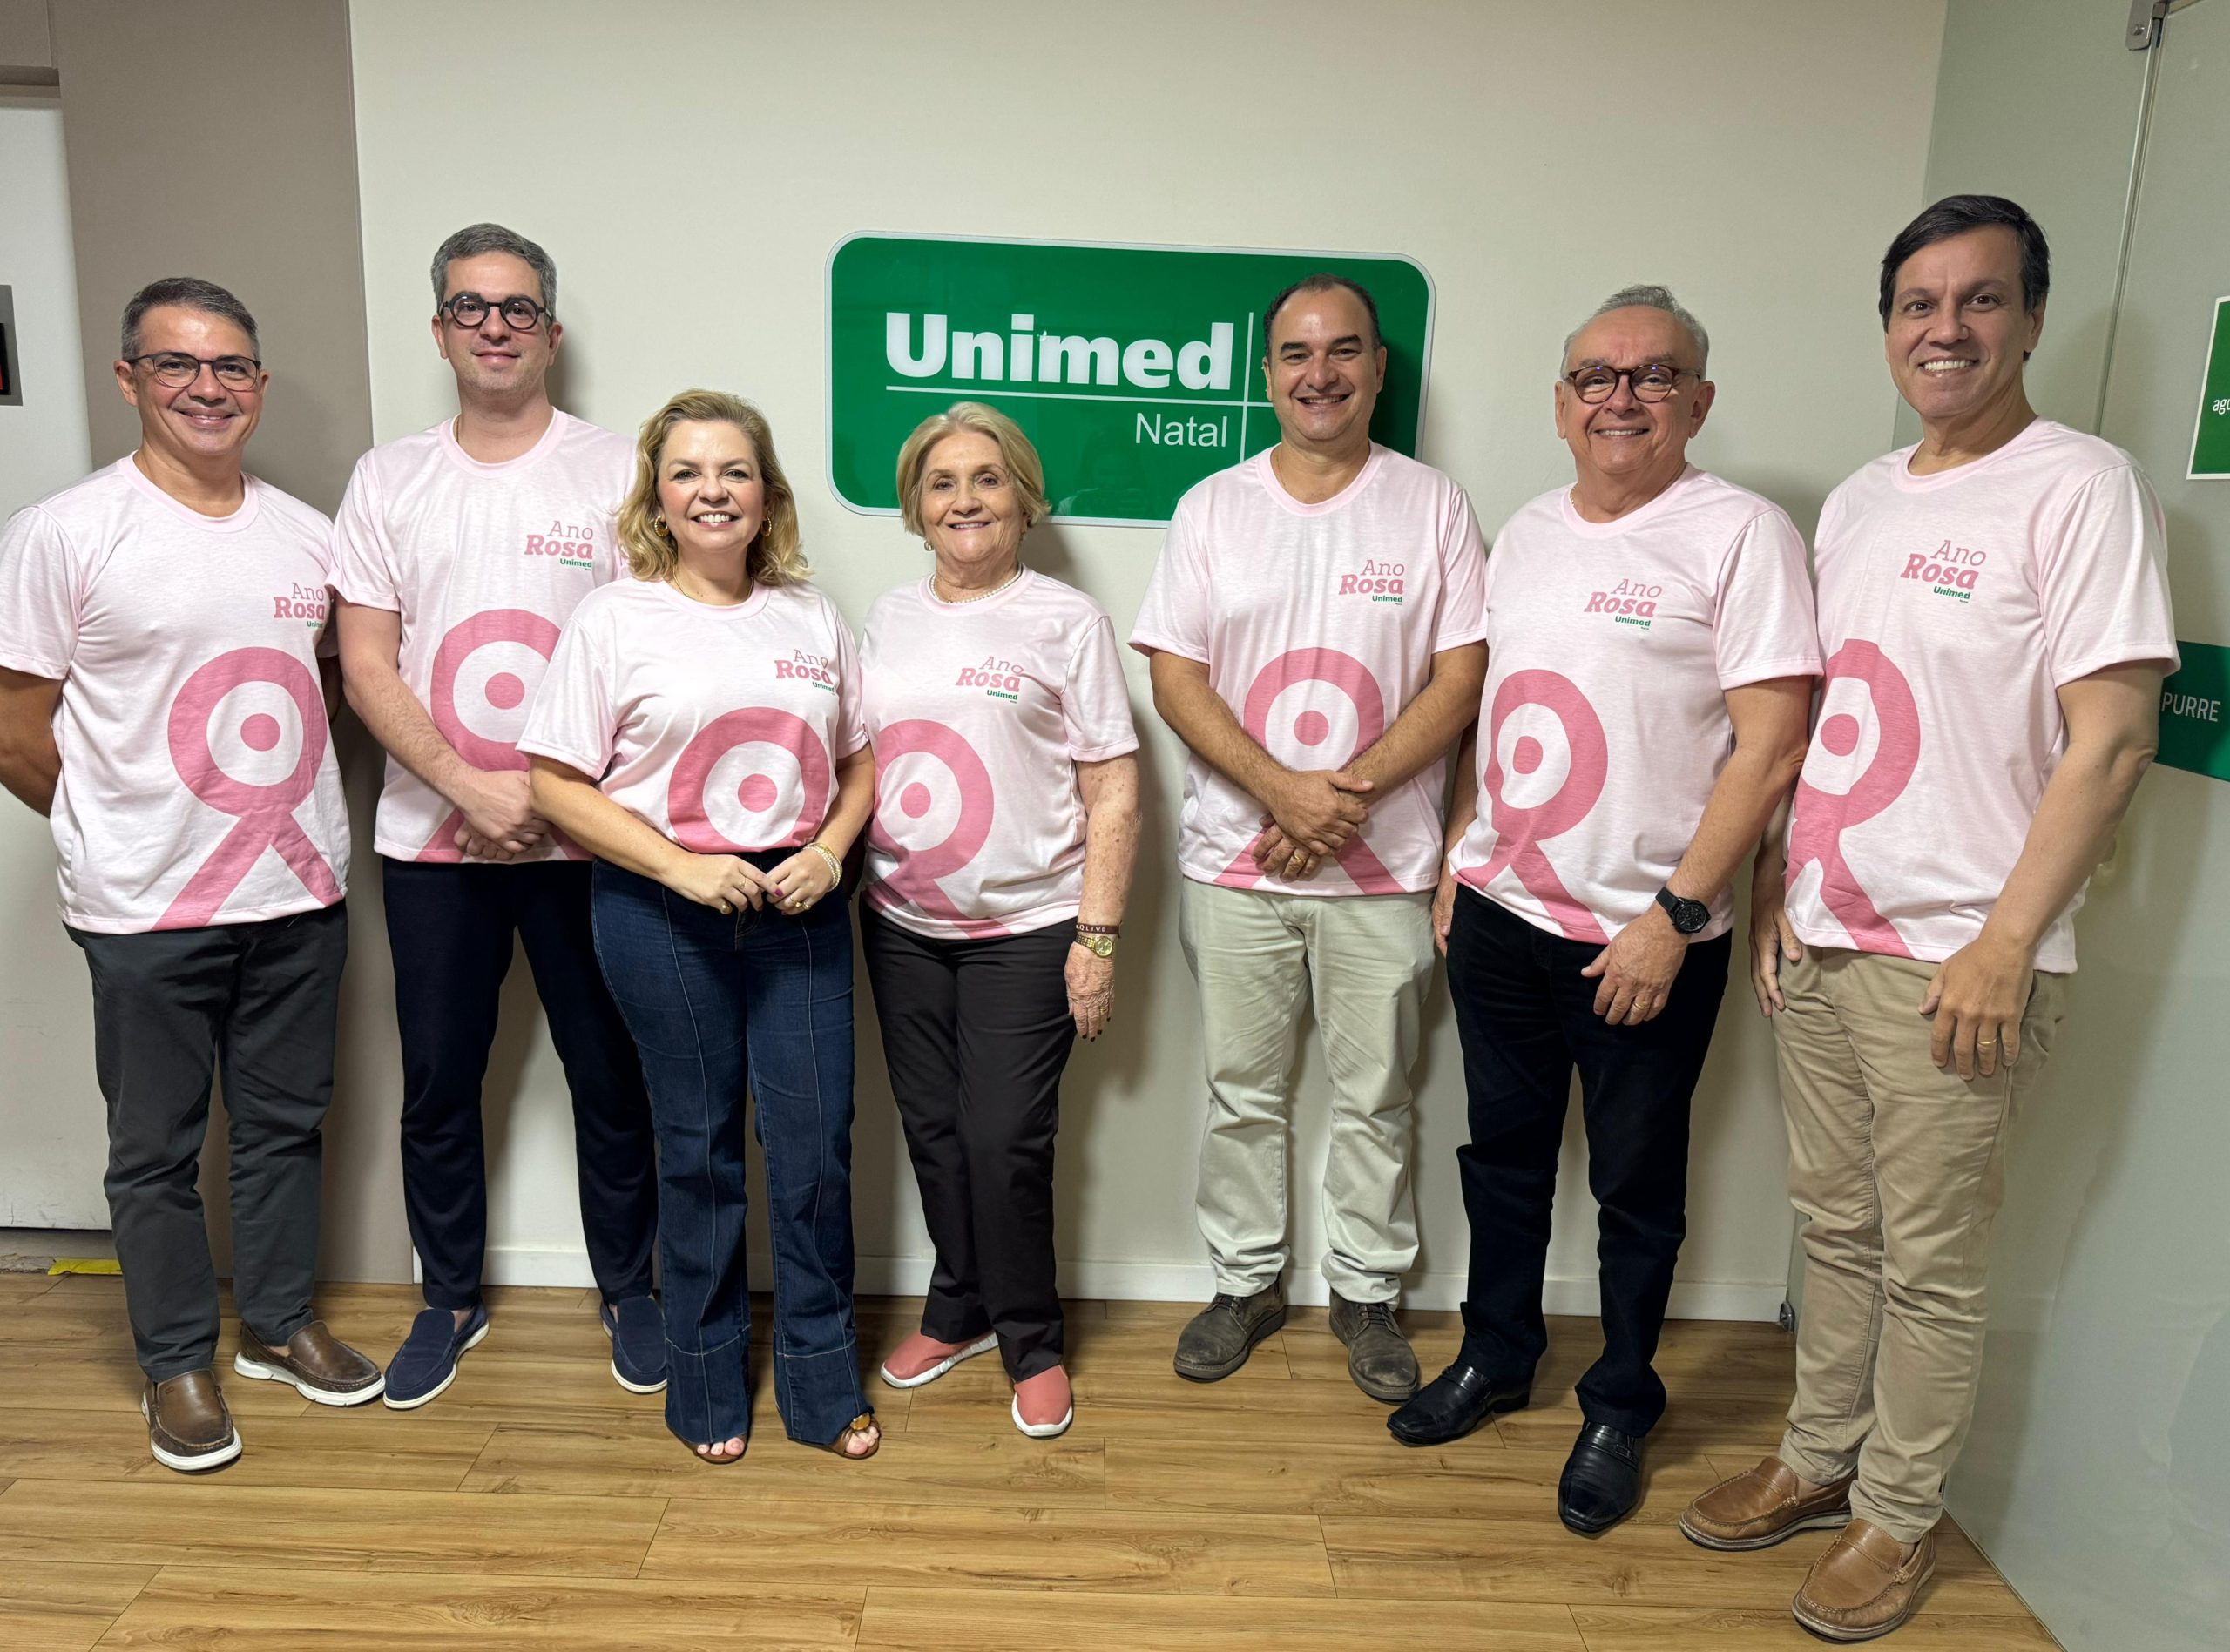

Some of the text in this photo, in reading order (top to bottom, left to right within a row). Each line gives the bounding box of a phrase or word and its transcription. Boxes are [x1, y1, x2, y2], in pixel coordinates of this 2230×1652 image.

[886, 312, 1234, 391] Unimed
[1136, 413, 1227, 448] Natal
[546, 520, 594, 541] Ano
[524, 534, 593, 560] Rosa
[1930, 539, 1987, 566] Ano
[559, 558, 592, 568] Unimed
[1360, 559, 1405, 577] Ano
[1900, 553, 1980, 590] Rosa
[291, 582, 324, 602] Ano
[1338, 574, 1404, 595] Rosa
[1610, 578, 1663, 598] Ano
[1933, 585, 1971, 600] Unimed
[273, 597, 326, 620] Rosa
[1584, 591, 1658, 618] Rosa
[1615, 615, 1652, 627] Unimed
[794, 649, 828, 670] Ano
[978, 656, 1024, 675] Ano
[774, 659, 834, 685] Rosa
[956, 668, 1021, 692] Rosa
[986, 689, 1018, 700] Unimed
